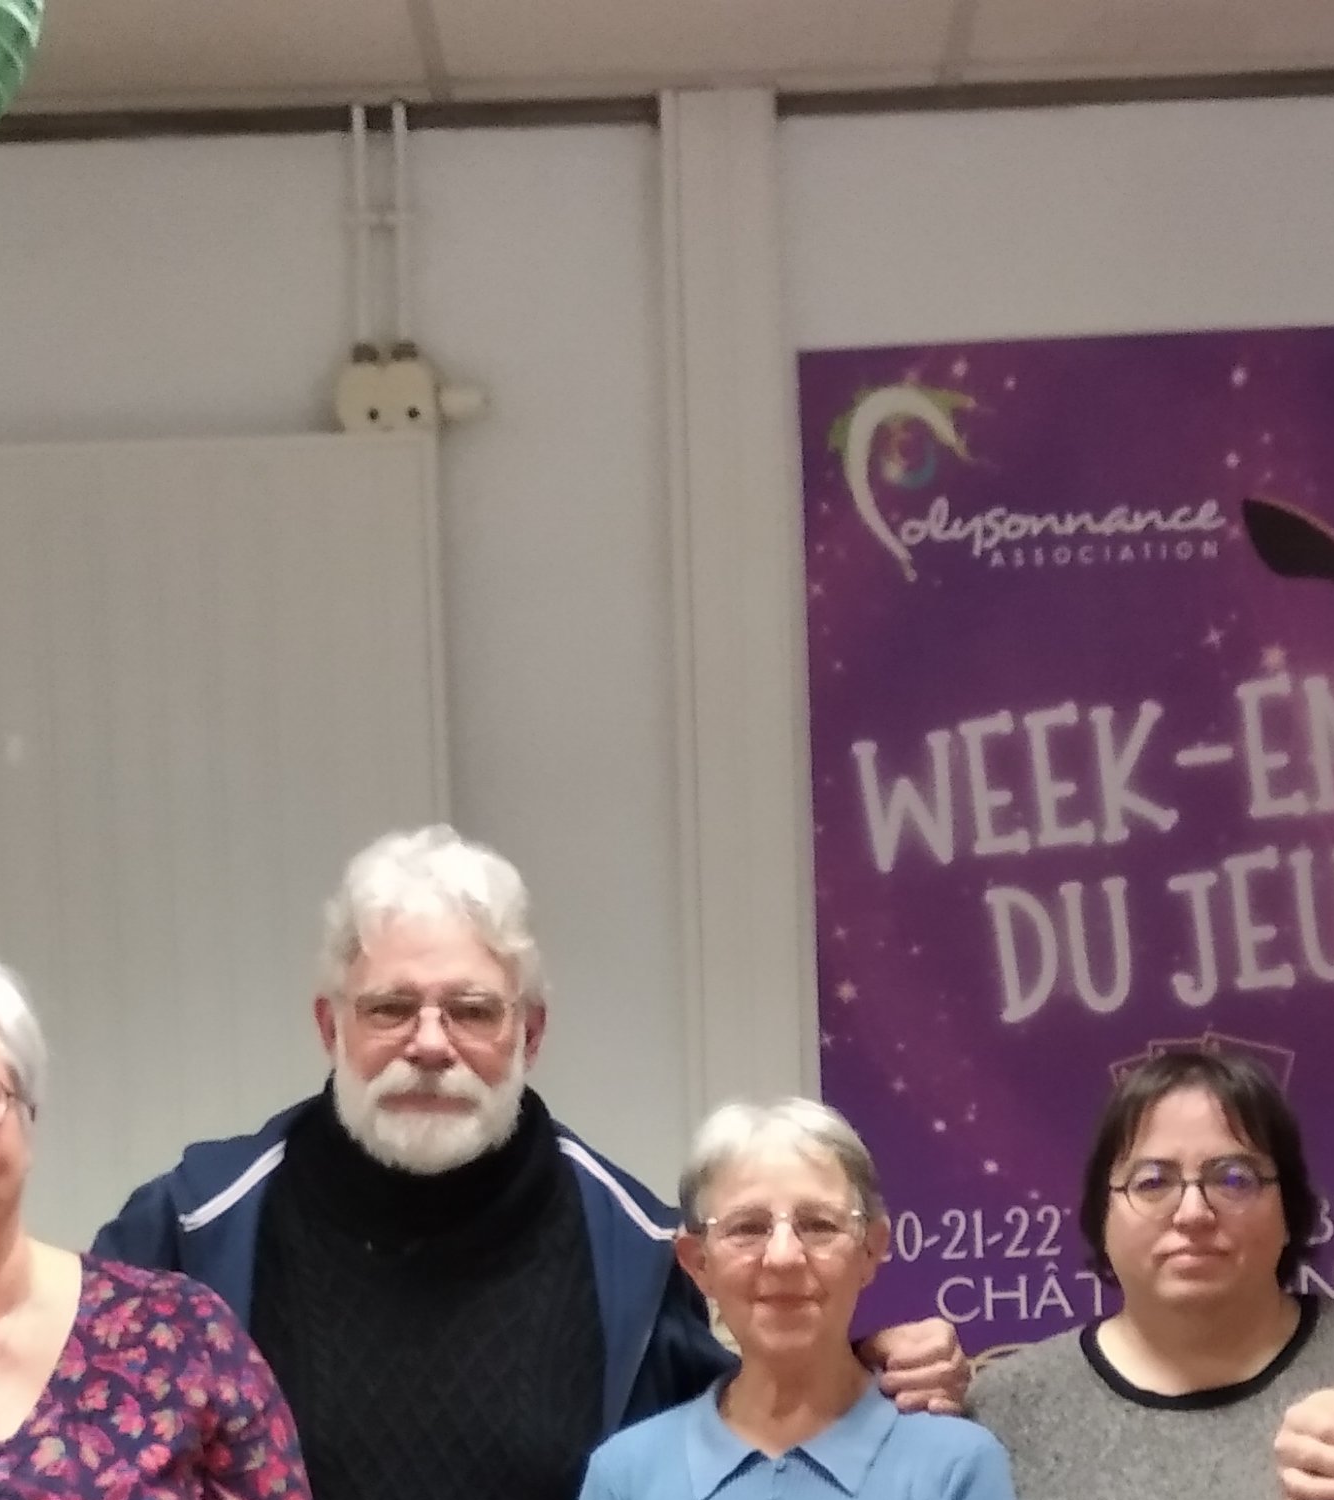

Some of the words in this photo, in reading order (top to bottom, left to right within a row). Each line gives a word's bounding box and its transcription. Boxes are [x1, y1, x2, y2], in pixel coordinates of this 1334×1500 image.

[990, 538, 1219, 570] ASSOCIATION
[985, 878, 1130, 1026] DU
[880, 1204, 1063, 1263] 0-21-22
